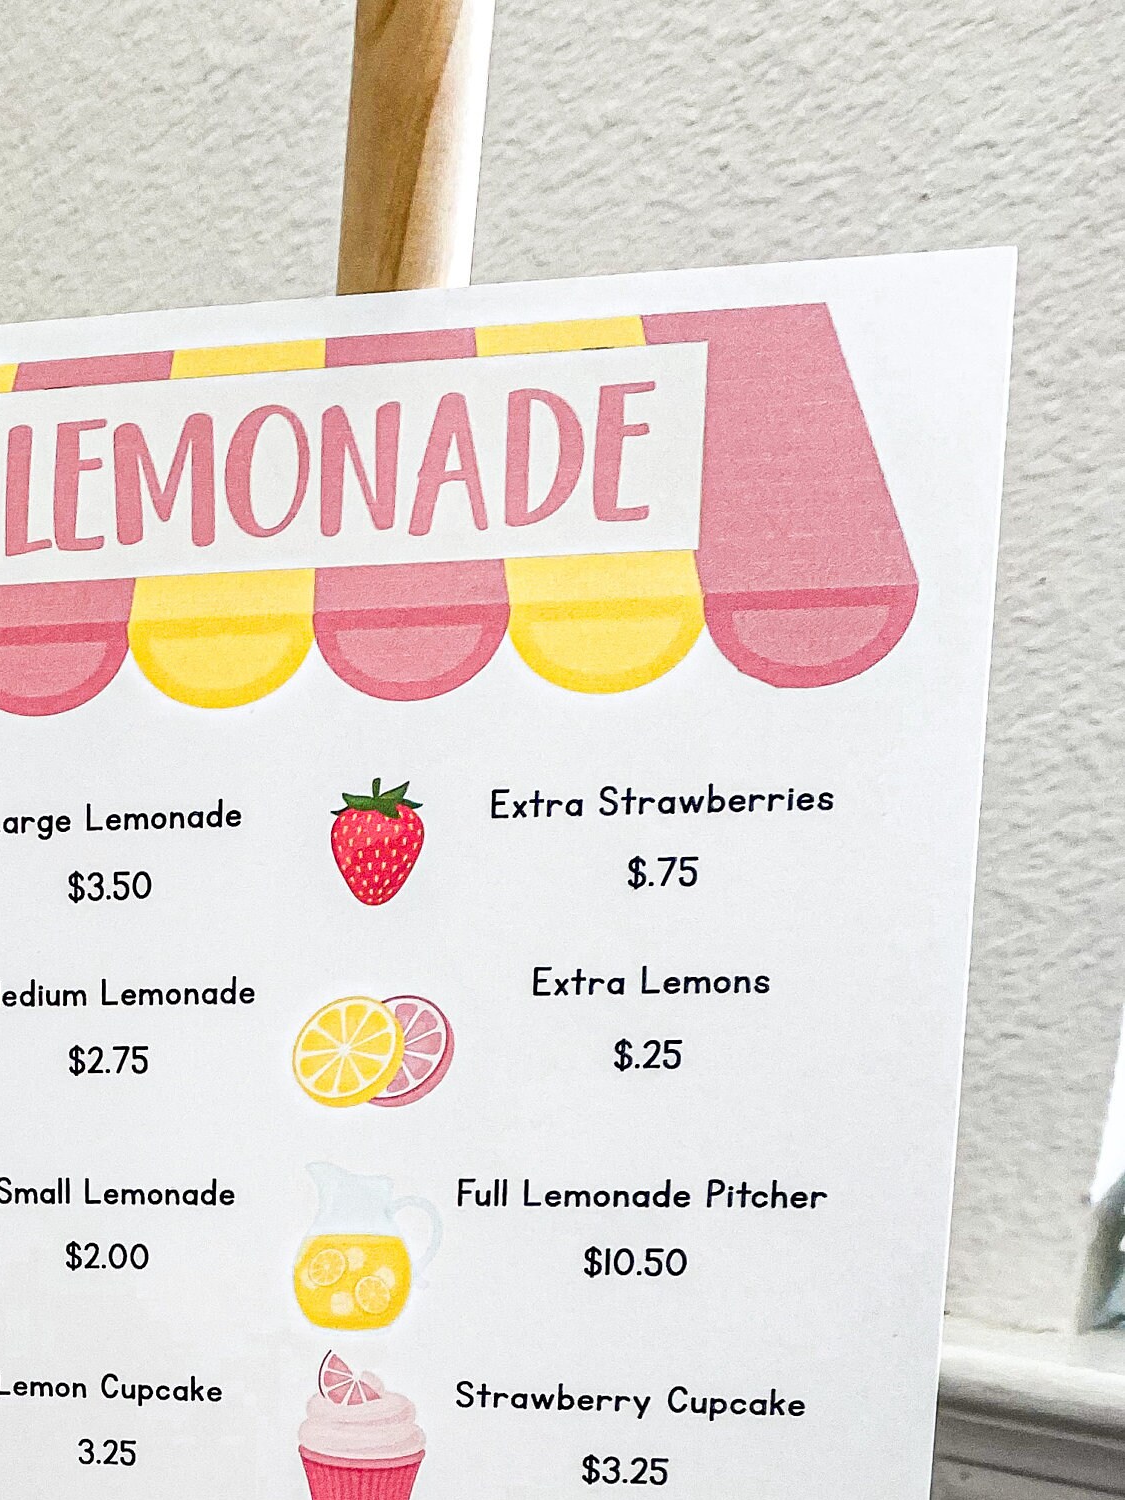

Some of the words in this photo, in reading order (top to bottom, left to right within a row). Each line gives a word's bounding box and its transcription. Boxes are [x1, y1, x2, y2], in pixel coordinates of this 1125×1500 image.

[5, 381, 656, 556] LEMONADE
[86, 798, 242, 832] Lemonade
[491, 788, 584, 819] Extra
[598, 783, 834, 817] Strawberries
[67, 870, 152, 904] $3.50
[627, 855, 699, 890] $.75
[101, 975, 255, 1006] Lemonade
[532, 966, 625, 997] Extra
[641, 965, 770, 995] Lemons
[68, 1044, 149, 1077] $2.75
[613, 1038, 683, 1072] $.25
[84, 1177, 235, 1206] Lemonade
[457, 1178, 508, 1207] Full
[523, 1178, 691, 1208] Lemonade
[706, 1178, 828, 1209] Pitcher
[65, 1240, 149, 1272] $2.00
[583, 1245, 688, 1279] $10.50
[100, 1373, 223, 1407] Cupcake
[455, 1380, 651, 1420] Strawberry
[667, 1385, 806, 1422] Cupcake
[77, 1438, 137, 1467] 3.25
[581, 1453, 670, 1486] $3.25
